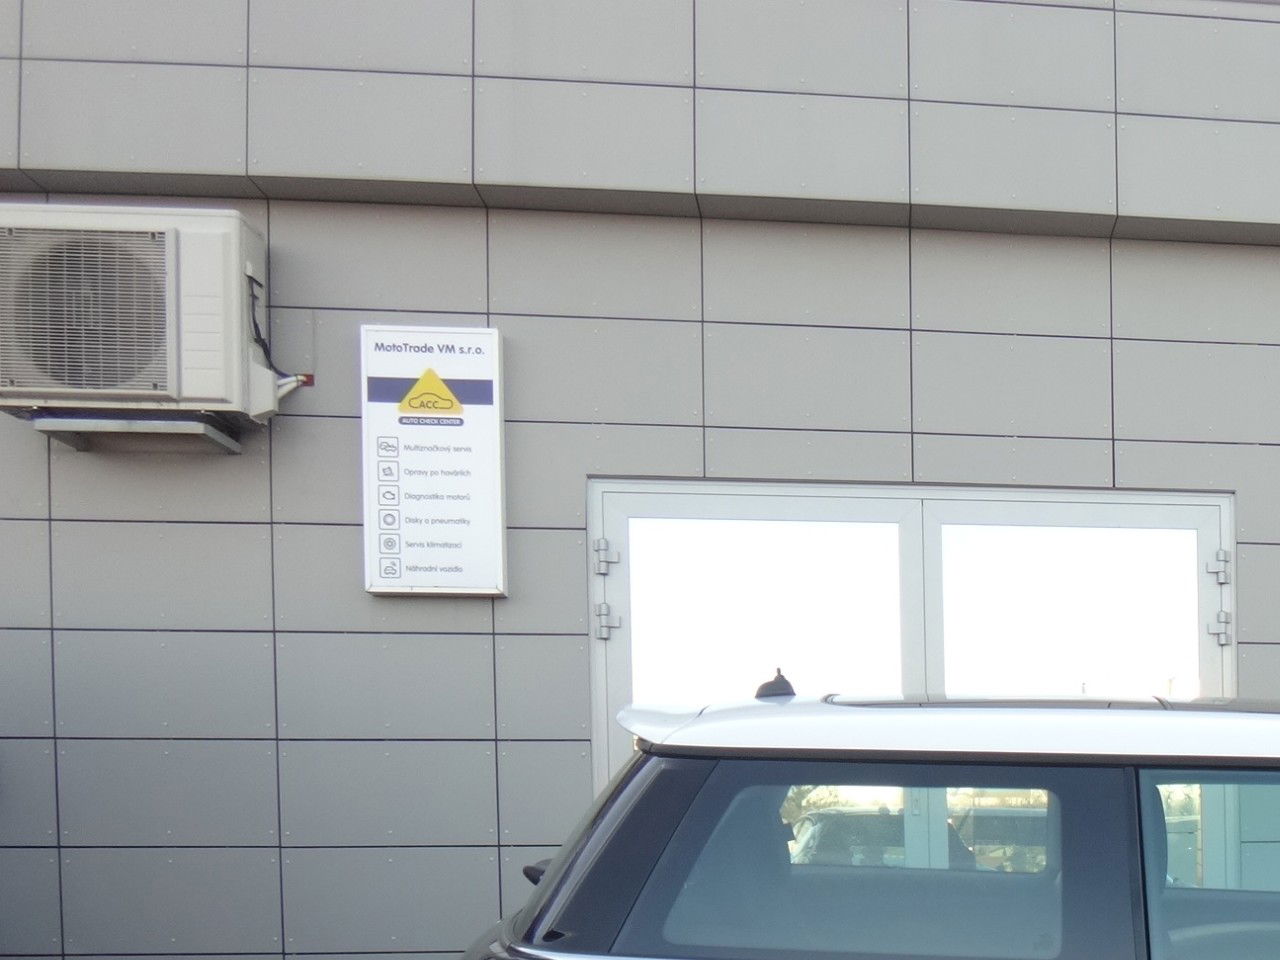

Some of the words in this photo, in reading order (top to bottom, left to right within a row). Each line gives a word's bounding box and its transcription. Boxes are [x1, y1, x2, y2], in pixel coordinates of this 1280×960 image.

[374, 342, 434, 354] MotoTrade
[437, 344, 456, 354] VM
[459, 346, 485, 355] s.r.o.
[419, 401, 439, 409] ACC
